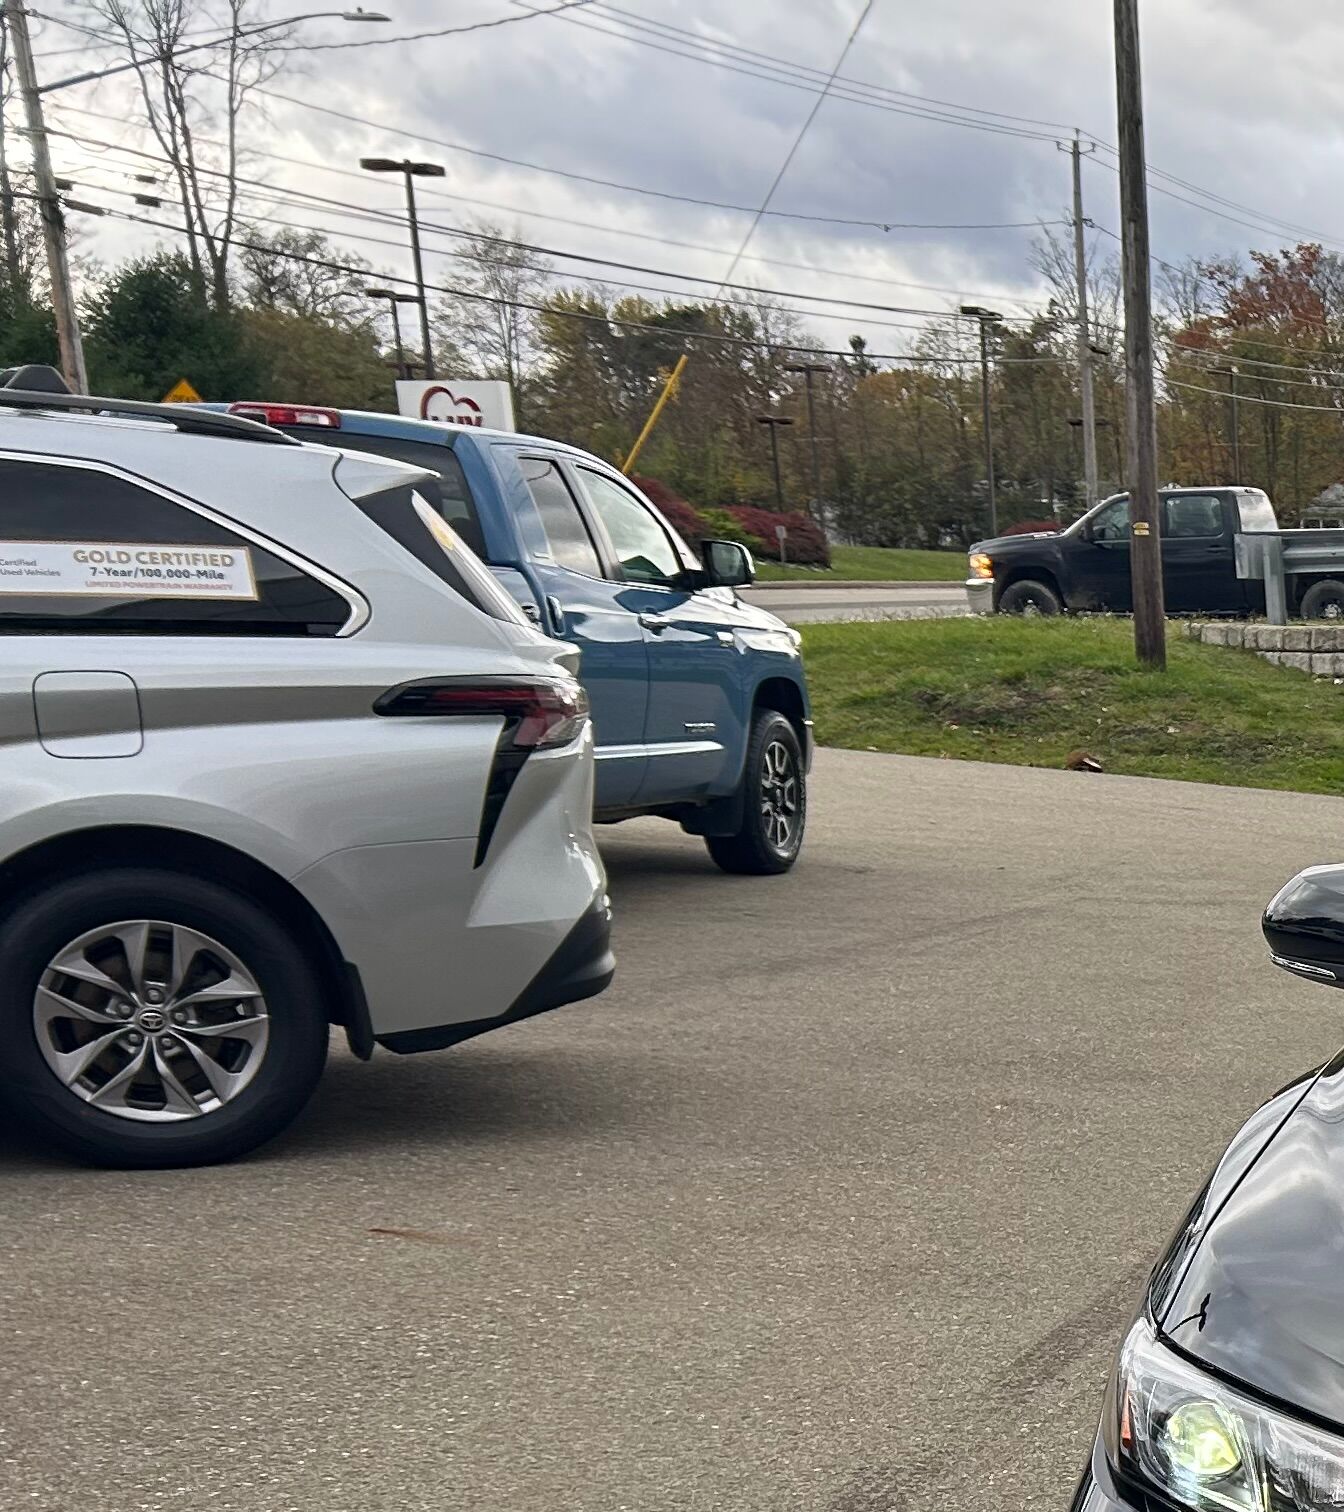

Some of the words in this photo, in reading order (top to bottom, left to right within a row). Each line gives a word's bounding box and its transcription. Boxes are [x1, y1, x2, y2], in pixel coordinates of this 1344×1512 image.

[0, 558, 37, 566] Certified
[73, 550, 131, 564] GOLD
[135, 551, 235, 568] CERTIFIED
[0, 568, 23, 576] Used
[89, 567, 225, 580] 7-Year/100,000-Mile
